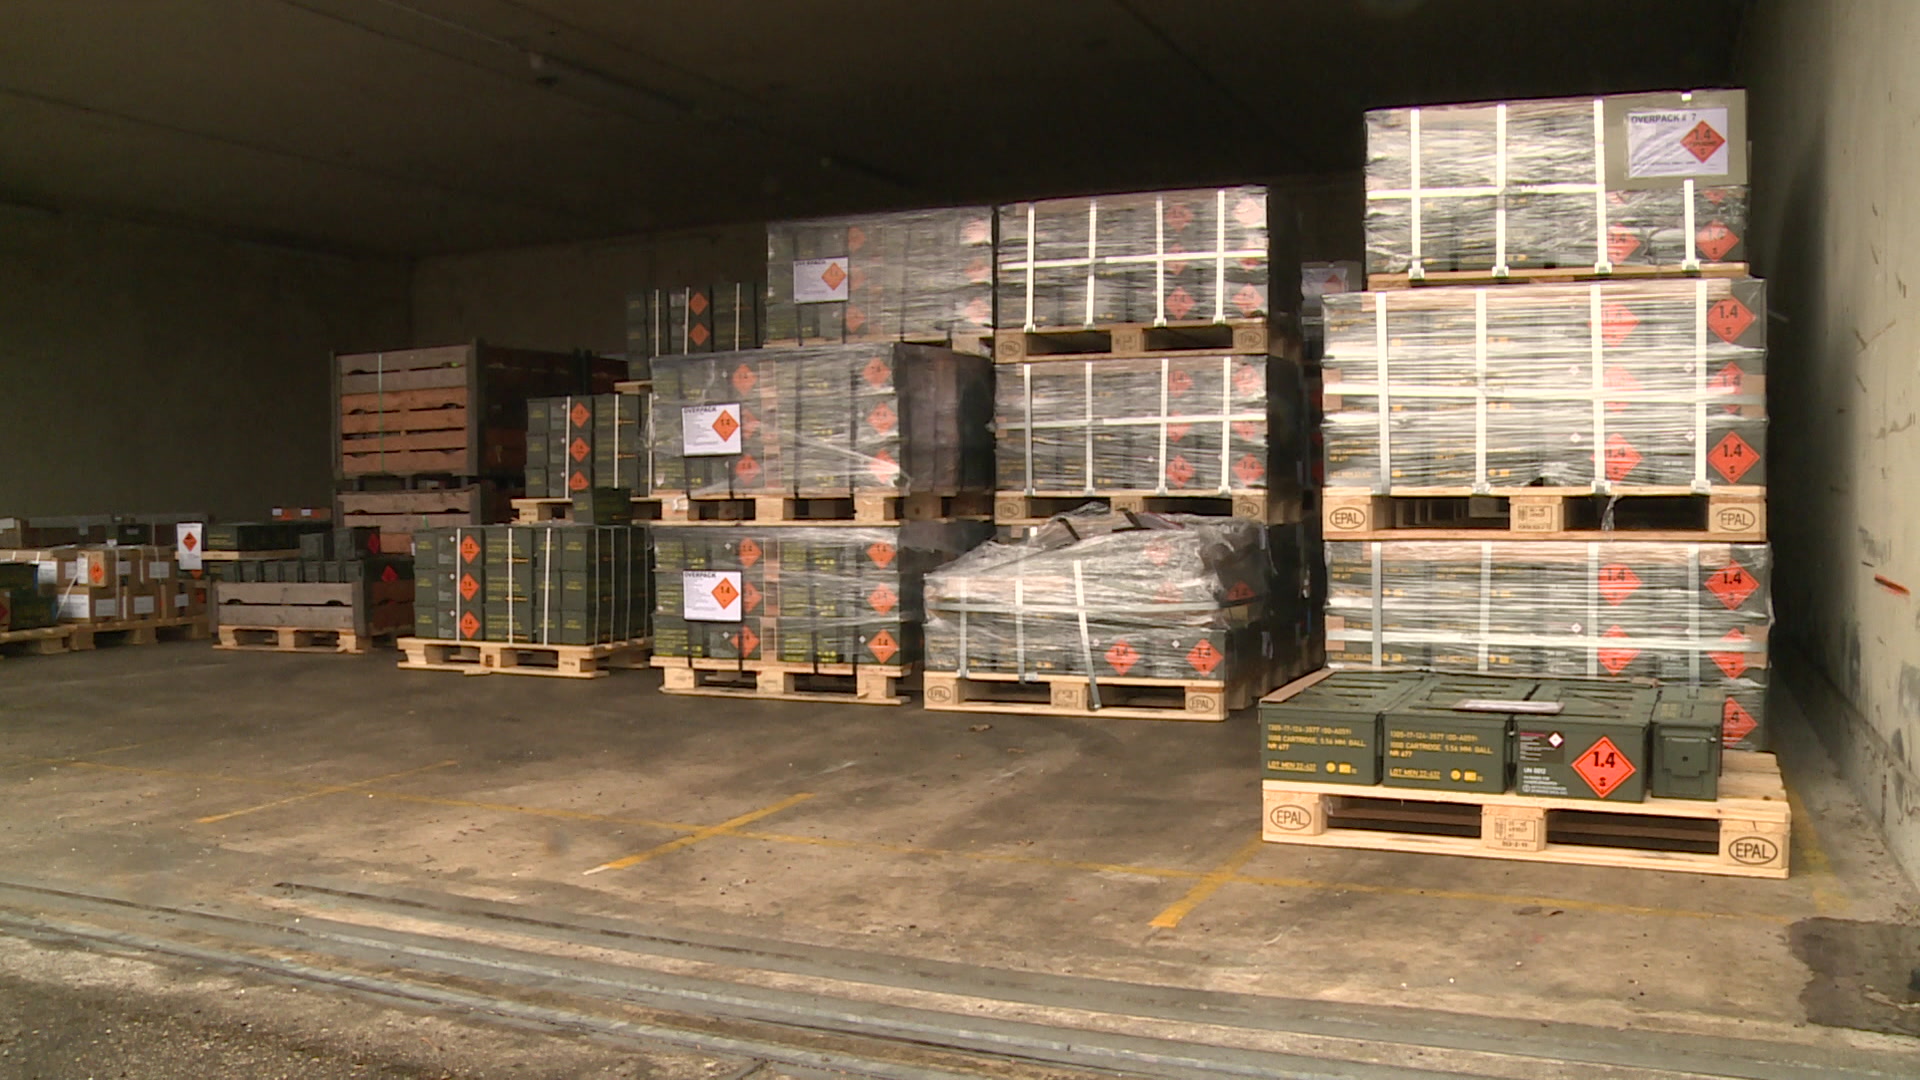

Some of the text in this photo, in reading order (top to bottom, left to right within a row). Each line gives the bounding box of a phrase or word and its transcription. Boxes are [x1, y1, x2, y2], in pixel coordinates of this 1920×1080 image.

[1631, 114, 1680, 123] OVERPACK
[1719, 306, 1738, 319] 1.4
[1722, 444, 1742, 458] 1.4
[1335, 512, 1360, 525] EPAL
[1607, 569, 1625, 581] 1.4
[1723, 571, 1741, 584] 1.4
[1593, 751, 1615, 768] 1.4
[1277, 810, 1306, 825] EPAL
[1736, 842, 1770, 859] EPAL
